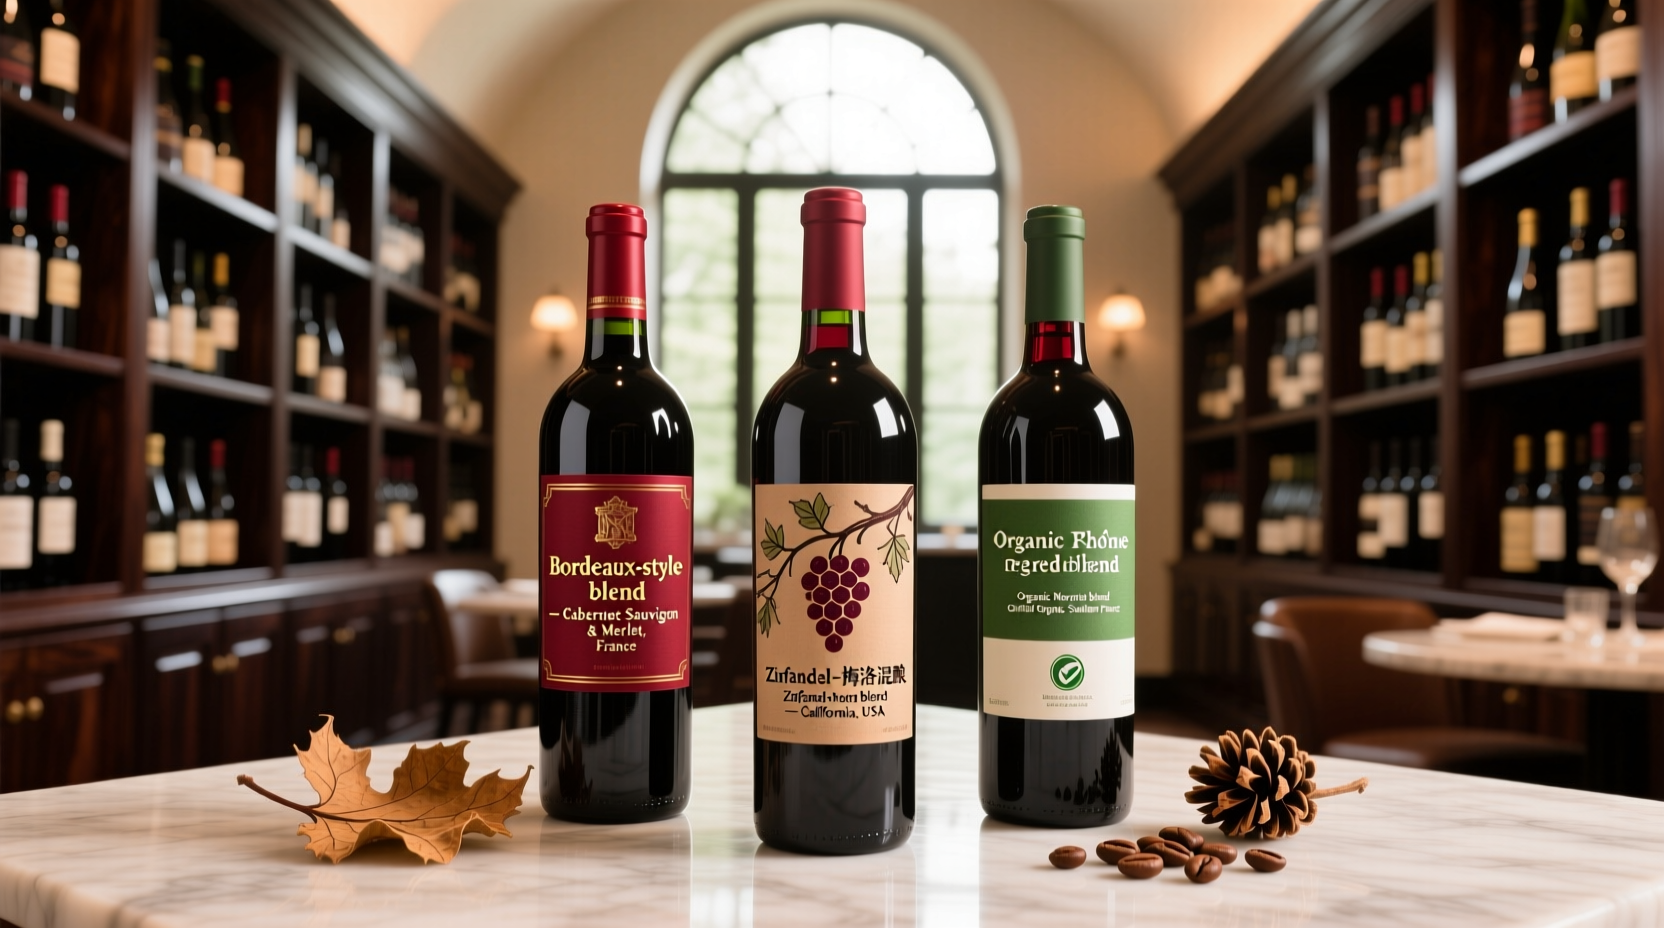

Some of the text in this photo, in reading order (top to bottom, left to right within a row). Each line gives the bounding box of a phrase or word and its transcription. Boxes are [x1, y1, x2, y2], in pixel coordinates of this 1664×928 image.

[994, 530, 1064, 554] Organic
[549, 554, 683, 582] Bordeaux-style
[589, 581, 646, 601] blend
[587, 624, 597, 637] &
[596, 639, 637, 652] France
[862, 704, 886, 717] USA
